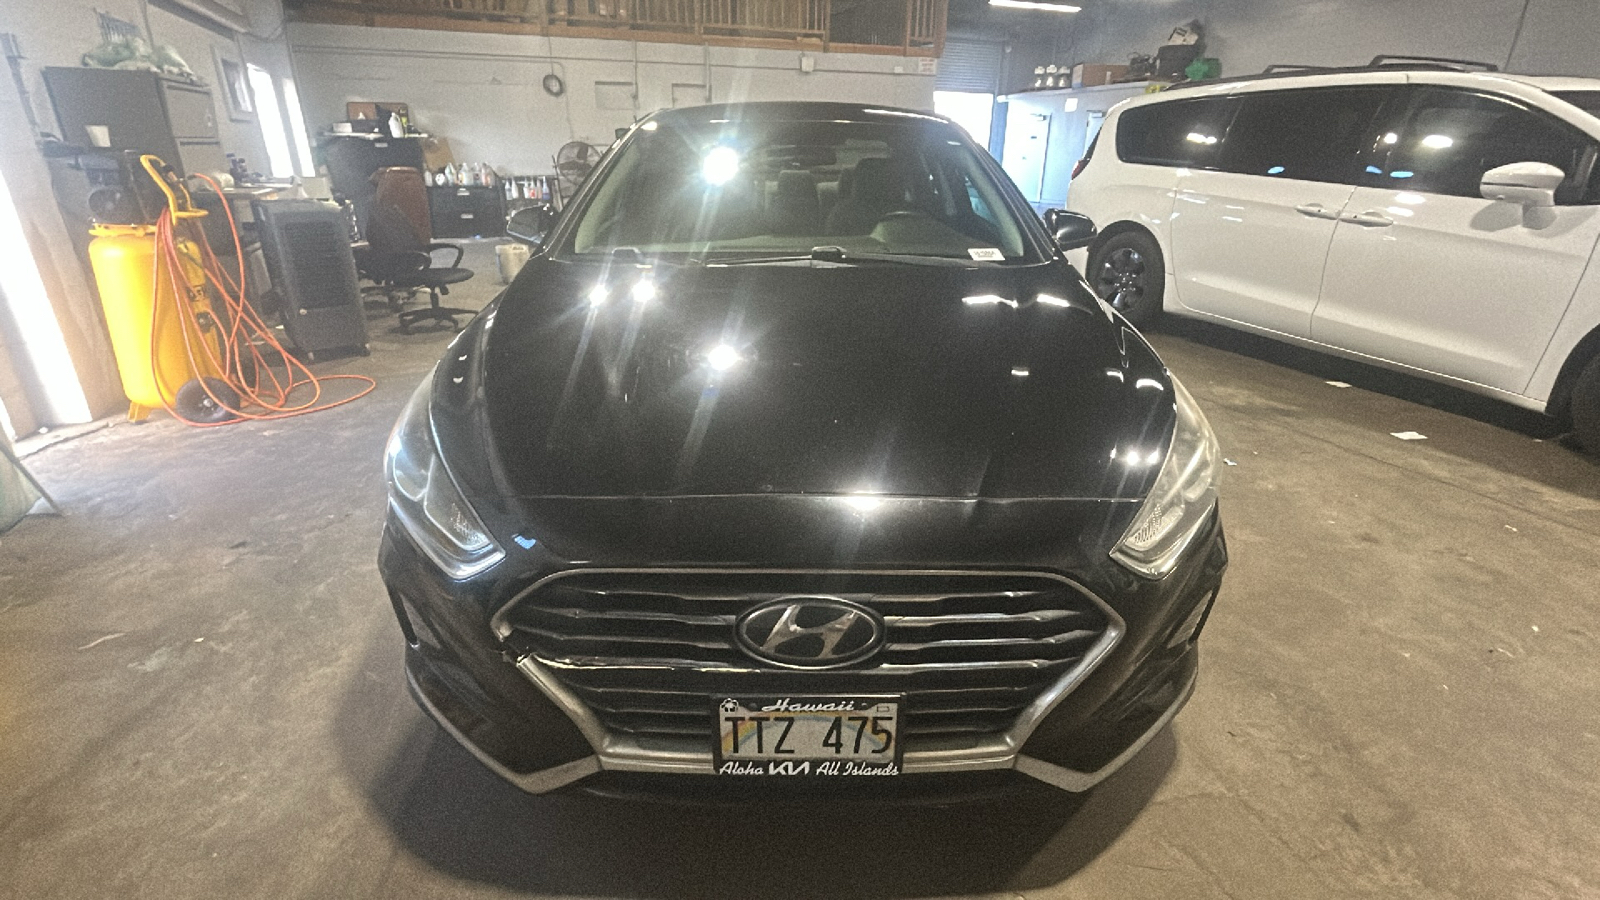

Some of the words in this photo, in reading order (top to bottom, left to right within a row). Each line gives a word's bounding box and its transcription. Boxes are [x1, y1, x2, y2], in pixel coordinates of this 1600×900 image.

[761, 697, 855, 712] Hawaii
[725, 716, 795, 754] TTZ
[822, 716, 893, 754] 475
[719, 761, 764, 775] Aloha
[816, 761, 839, 776] All
[842, 761, 899, 776] Islands
